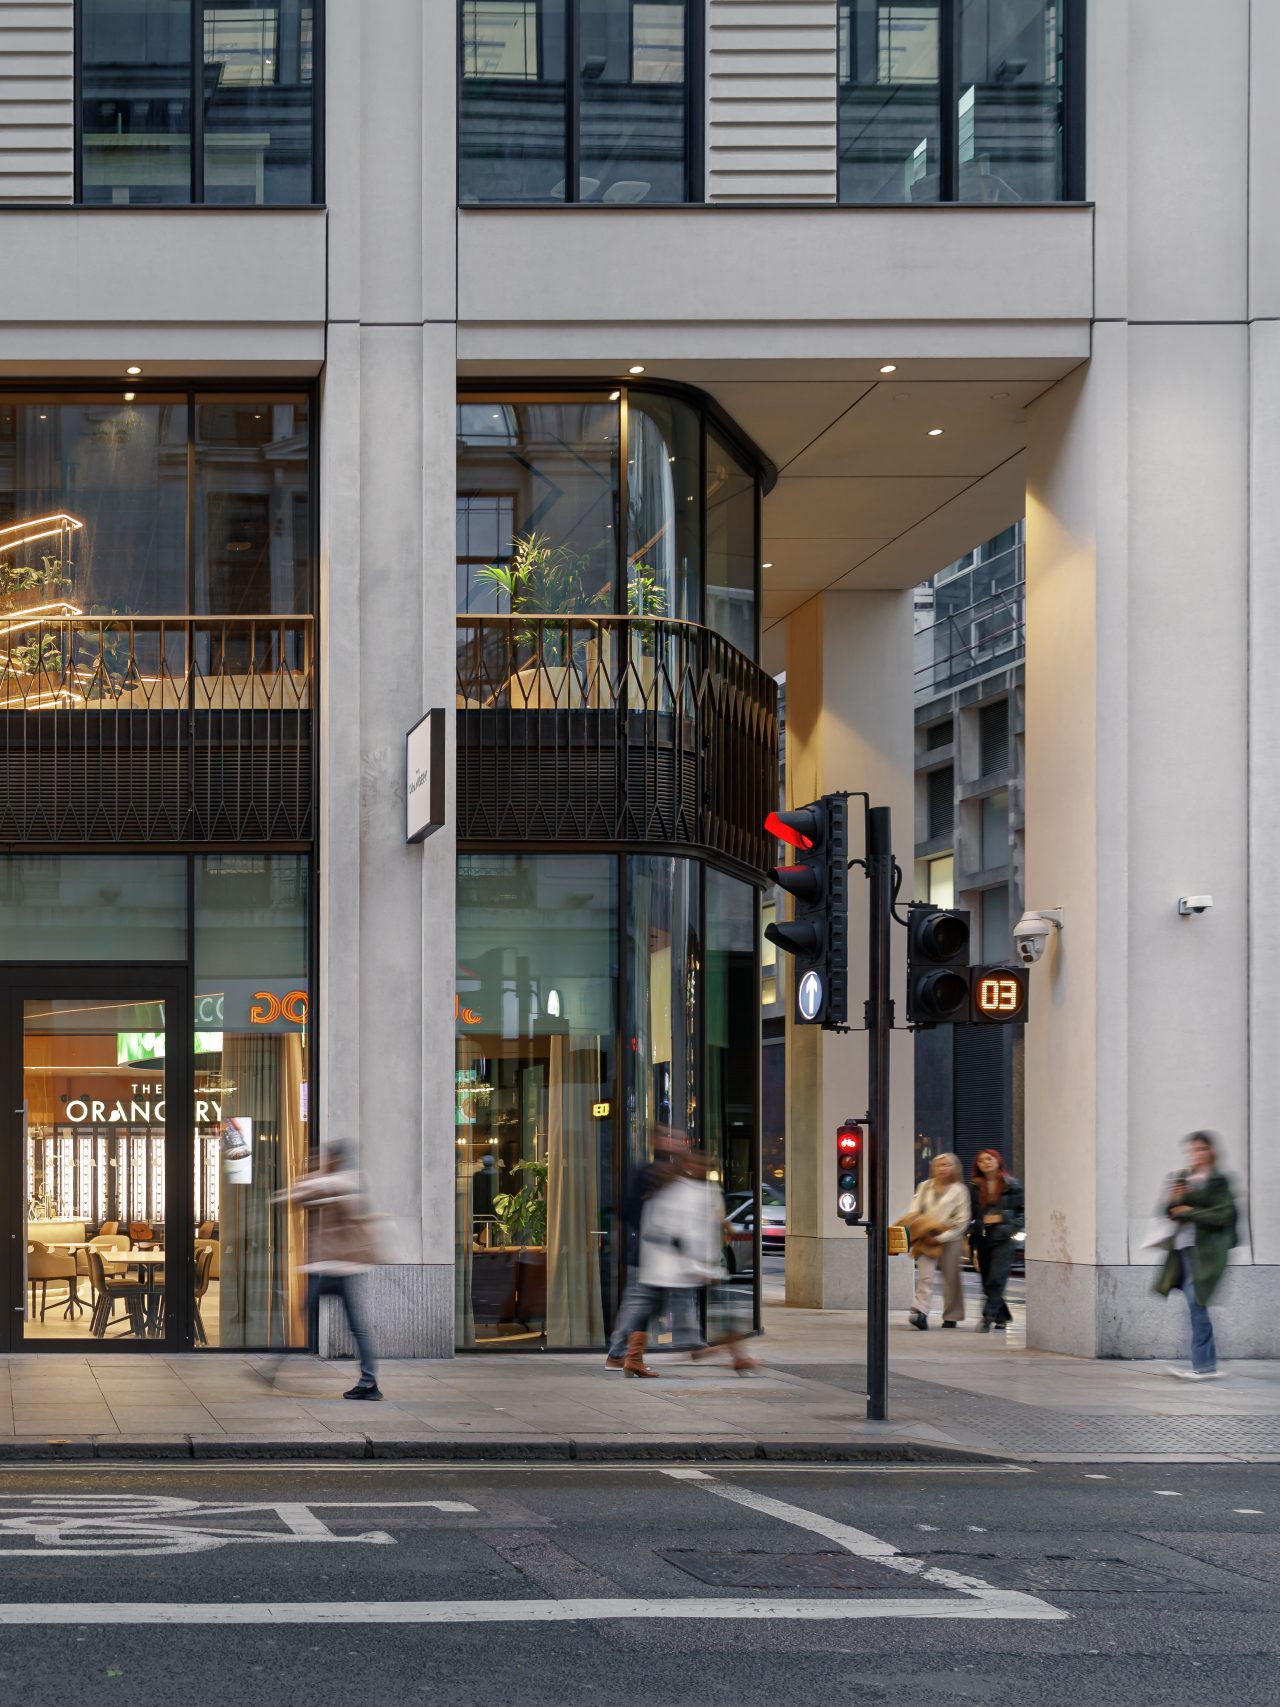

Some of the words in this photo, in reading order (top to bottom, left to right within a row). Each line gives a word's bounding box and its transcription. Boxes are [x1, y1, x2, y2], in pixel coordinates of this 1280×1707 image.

[981, 980, 1016, 1009] 03
[131, 1084, 162, 1094] THE
[66, 1100, 222, 1122] ORANRY
